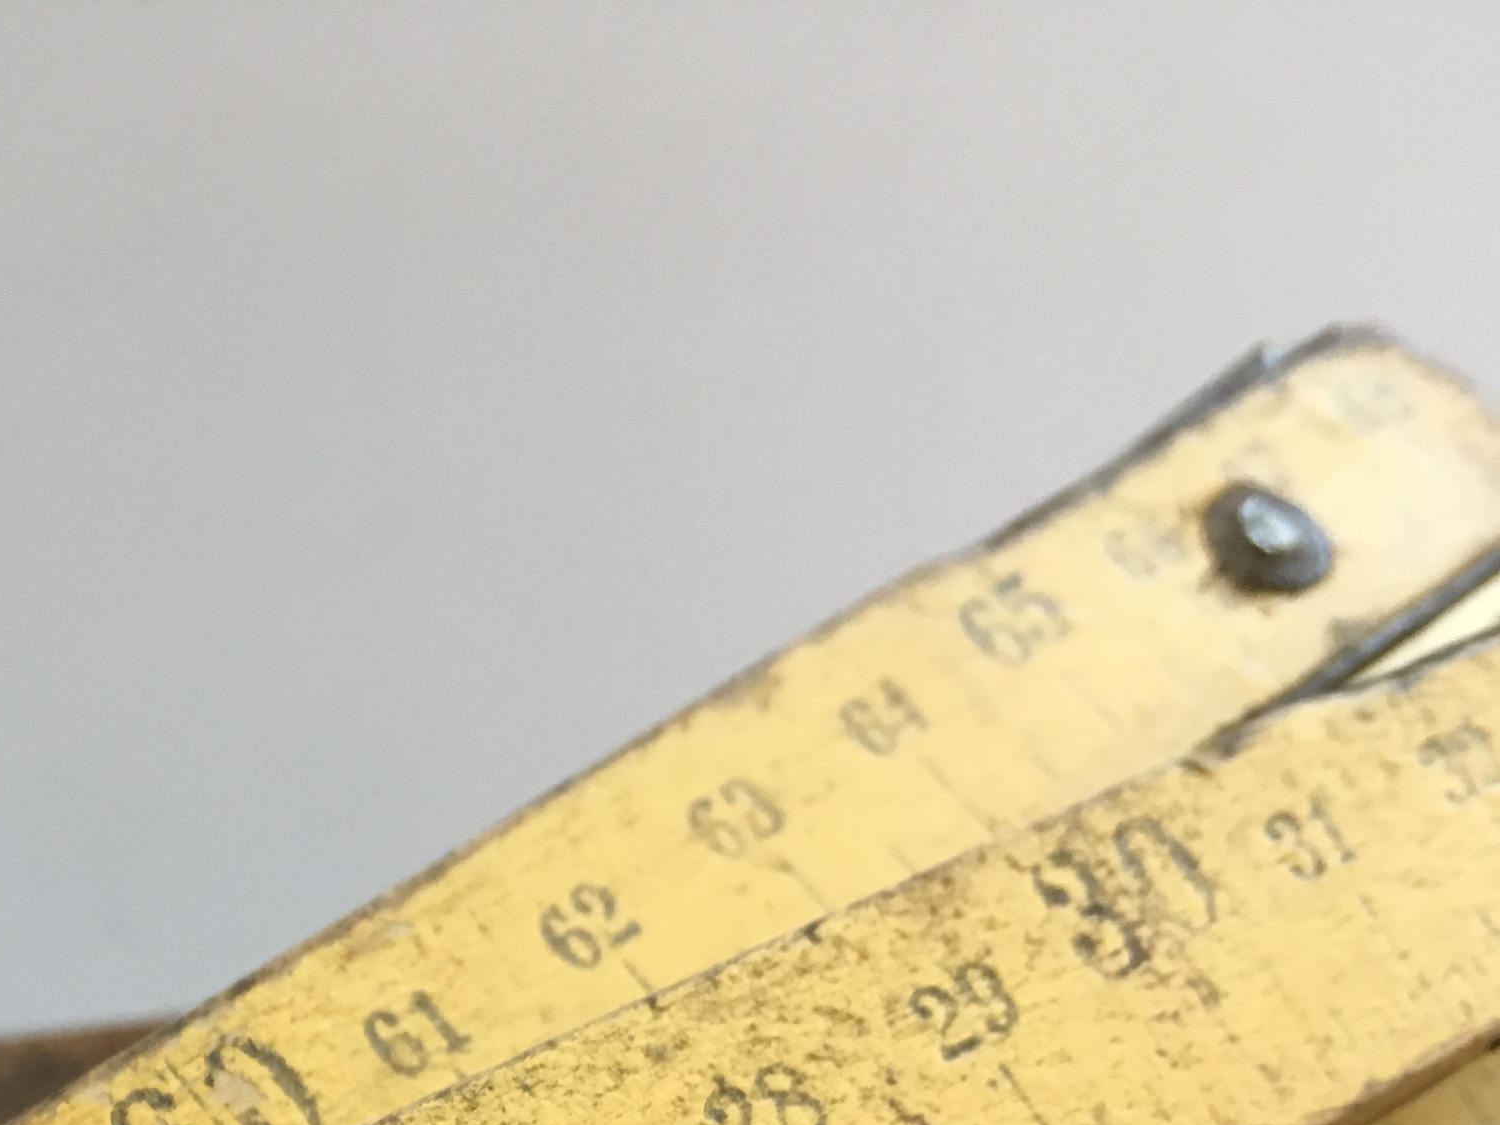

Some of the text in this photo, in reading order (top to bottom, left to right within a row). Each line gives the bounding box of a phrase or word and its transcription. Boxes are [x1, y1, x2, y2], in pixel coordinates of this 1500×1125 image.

[957, 572, 1071, 666] 65
[838, 677, 928, 757] 64
[687, 778, 786, 860] 63
[1263, 791, 1357, 880] 31
[539, 883, 642, 970] 62
[1031, 816, 1217, 979] 30
[363, 991, 474, 1077] 61
[910, 962, 1018, 1061] 29
